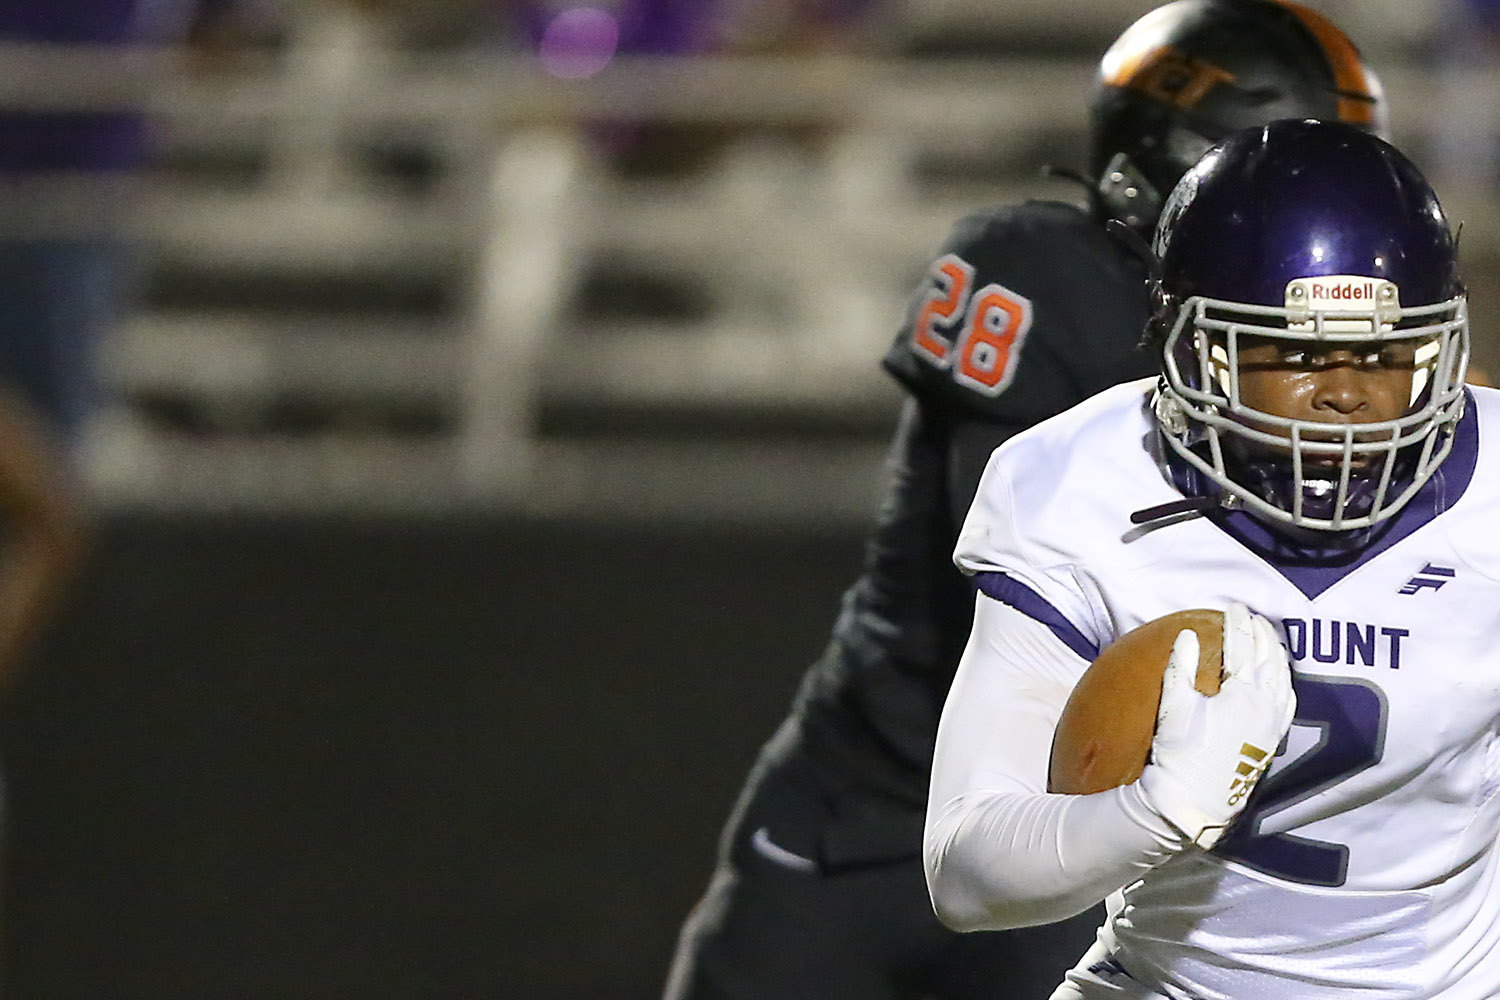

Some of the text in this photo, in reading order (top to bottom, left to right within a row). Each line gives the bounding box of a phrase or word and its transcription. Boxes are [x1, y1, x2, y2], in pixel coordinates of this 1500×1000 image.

[911, 253, 1033, 398] 28
[1312, 283, 1373, 299] Riddell
[1206, 670, 1390, 888] 2
